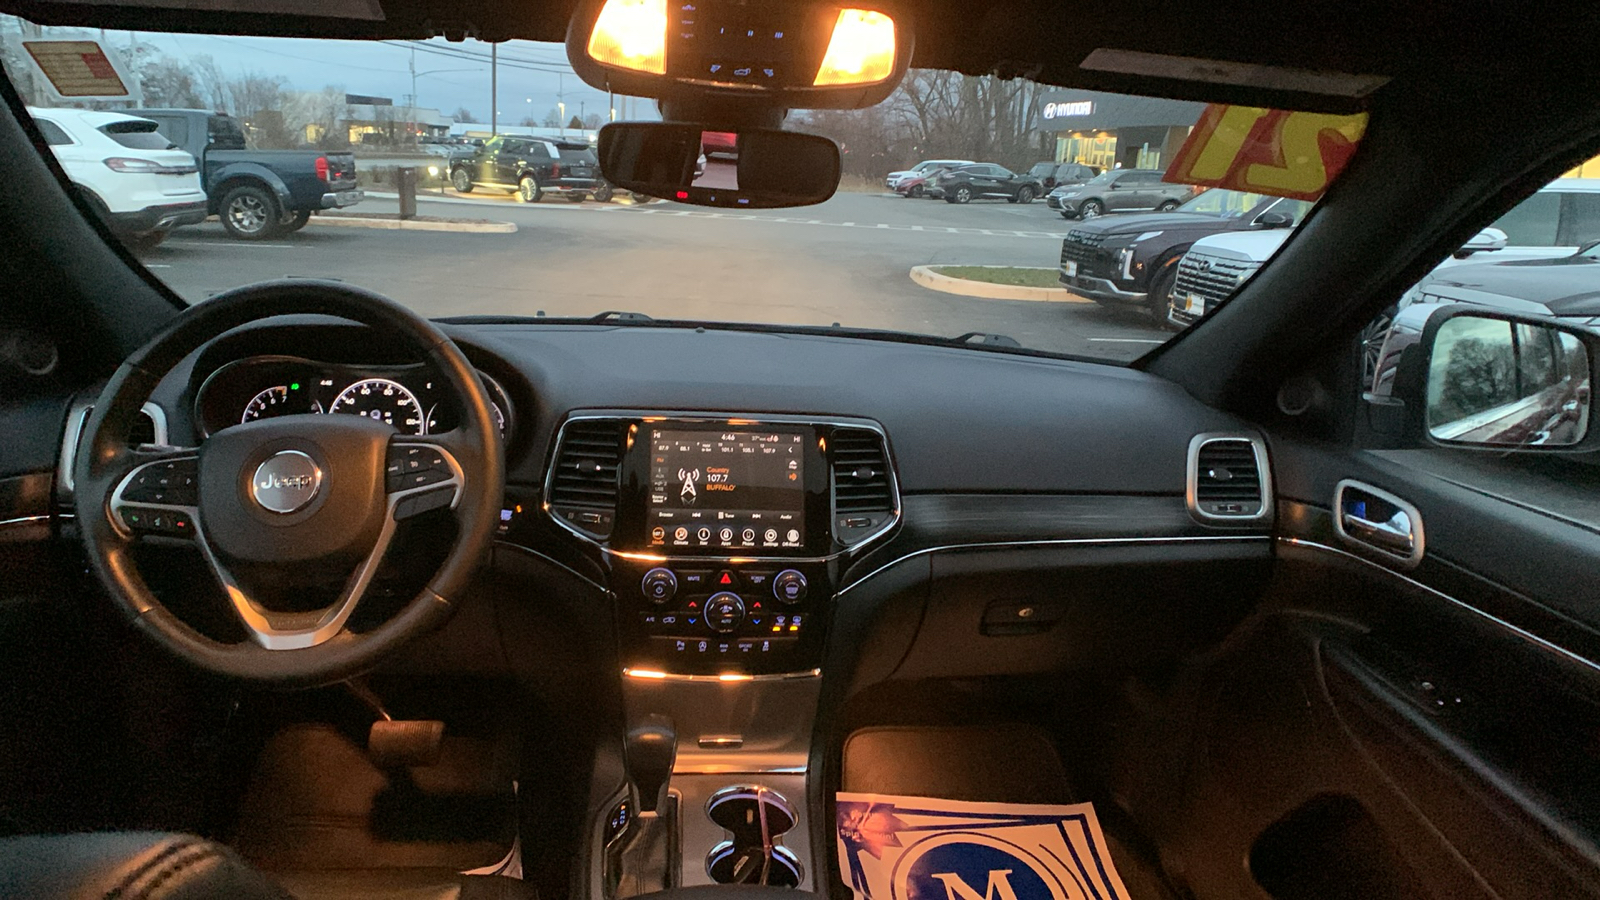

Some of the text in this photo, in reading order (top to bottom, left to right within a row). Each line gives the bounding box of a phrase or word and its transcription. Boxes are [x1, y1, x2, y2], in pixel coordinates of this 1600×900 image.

[1056, 101, 1092, 117] HYUNDAI
[721, 433, 736, 441] 4:46
[706, 466, 730, 474] Country
[260, 473, 312, 491] Jeep
[707, 474, 728, 482] 107.7
